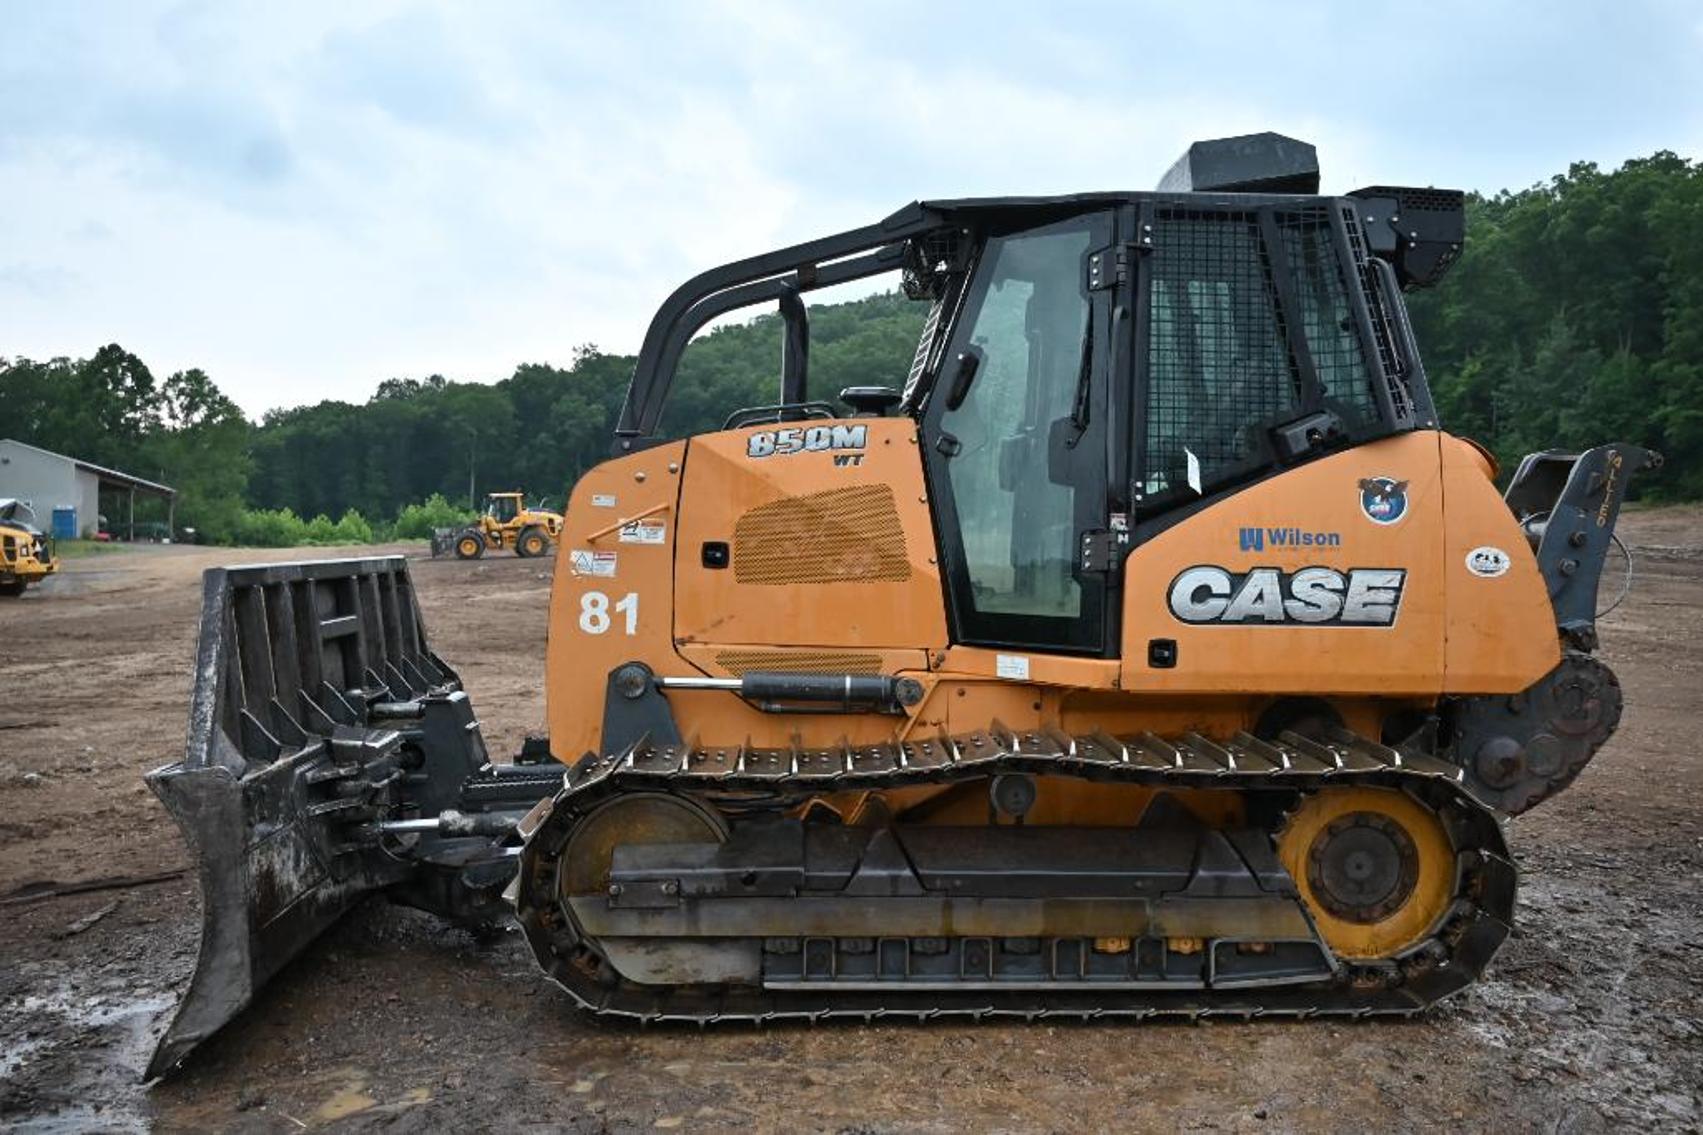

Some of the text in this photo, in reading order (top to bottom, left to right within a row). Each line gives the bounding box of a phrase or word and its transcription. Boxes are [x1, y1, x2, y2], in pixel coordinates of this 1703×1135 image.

[747, 425, 867, 457] 850M
[1267, 528, 1340, 546] Wilson
[579, 590, 639, 636] 81
[1168, 566, 1404, 625] CASE
